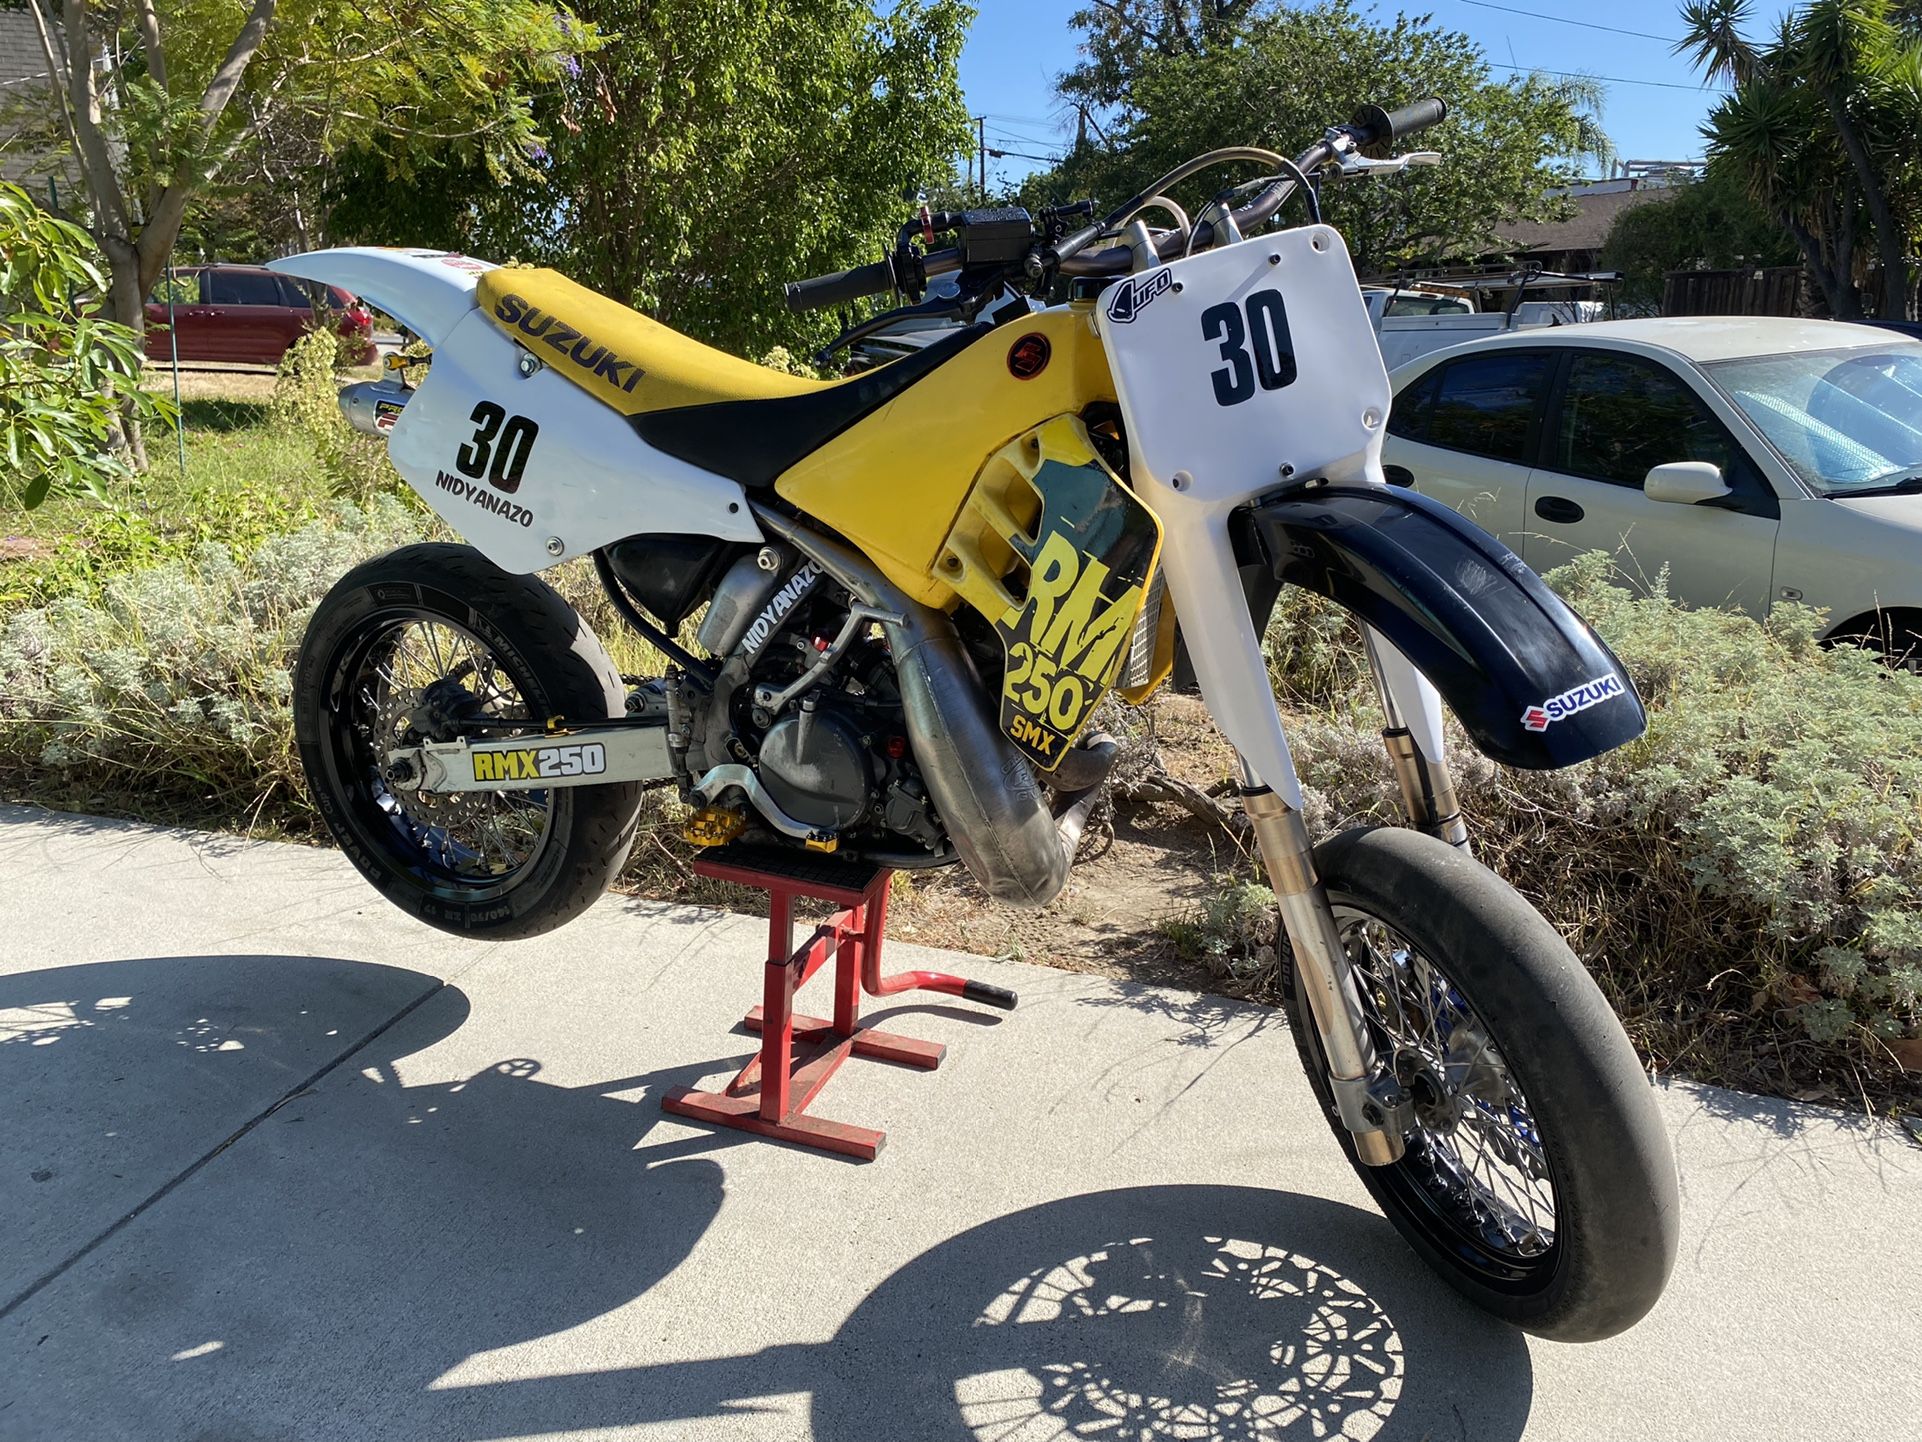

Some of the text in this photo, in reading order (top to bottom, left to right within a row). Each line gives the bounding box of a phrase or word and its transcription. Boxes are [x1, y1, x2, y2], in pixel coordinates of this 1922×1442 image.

[1132, 271, 1170, 310] UFO
[494, 293, 647, 394] SUZUKI
[1200, 288, 1298, 407] 30
[455, 400, 540, 495] 30
[435, 468, 534, 528] NIDYANAZO
[1003, 641, 1084, 732] 250
[1546, 676, 1622, 719] SUZUKI
[472, 743, 606, 781] RMX250
[1009, 713, 1056, 757] SMX
